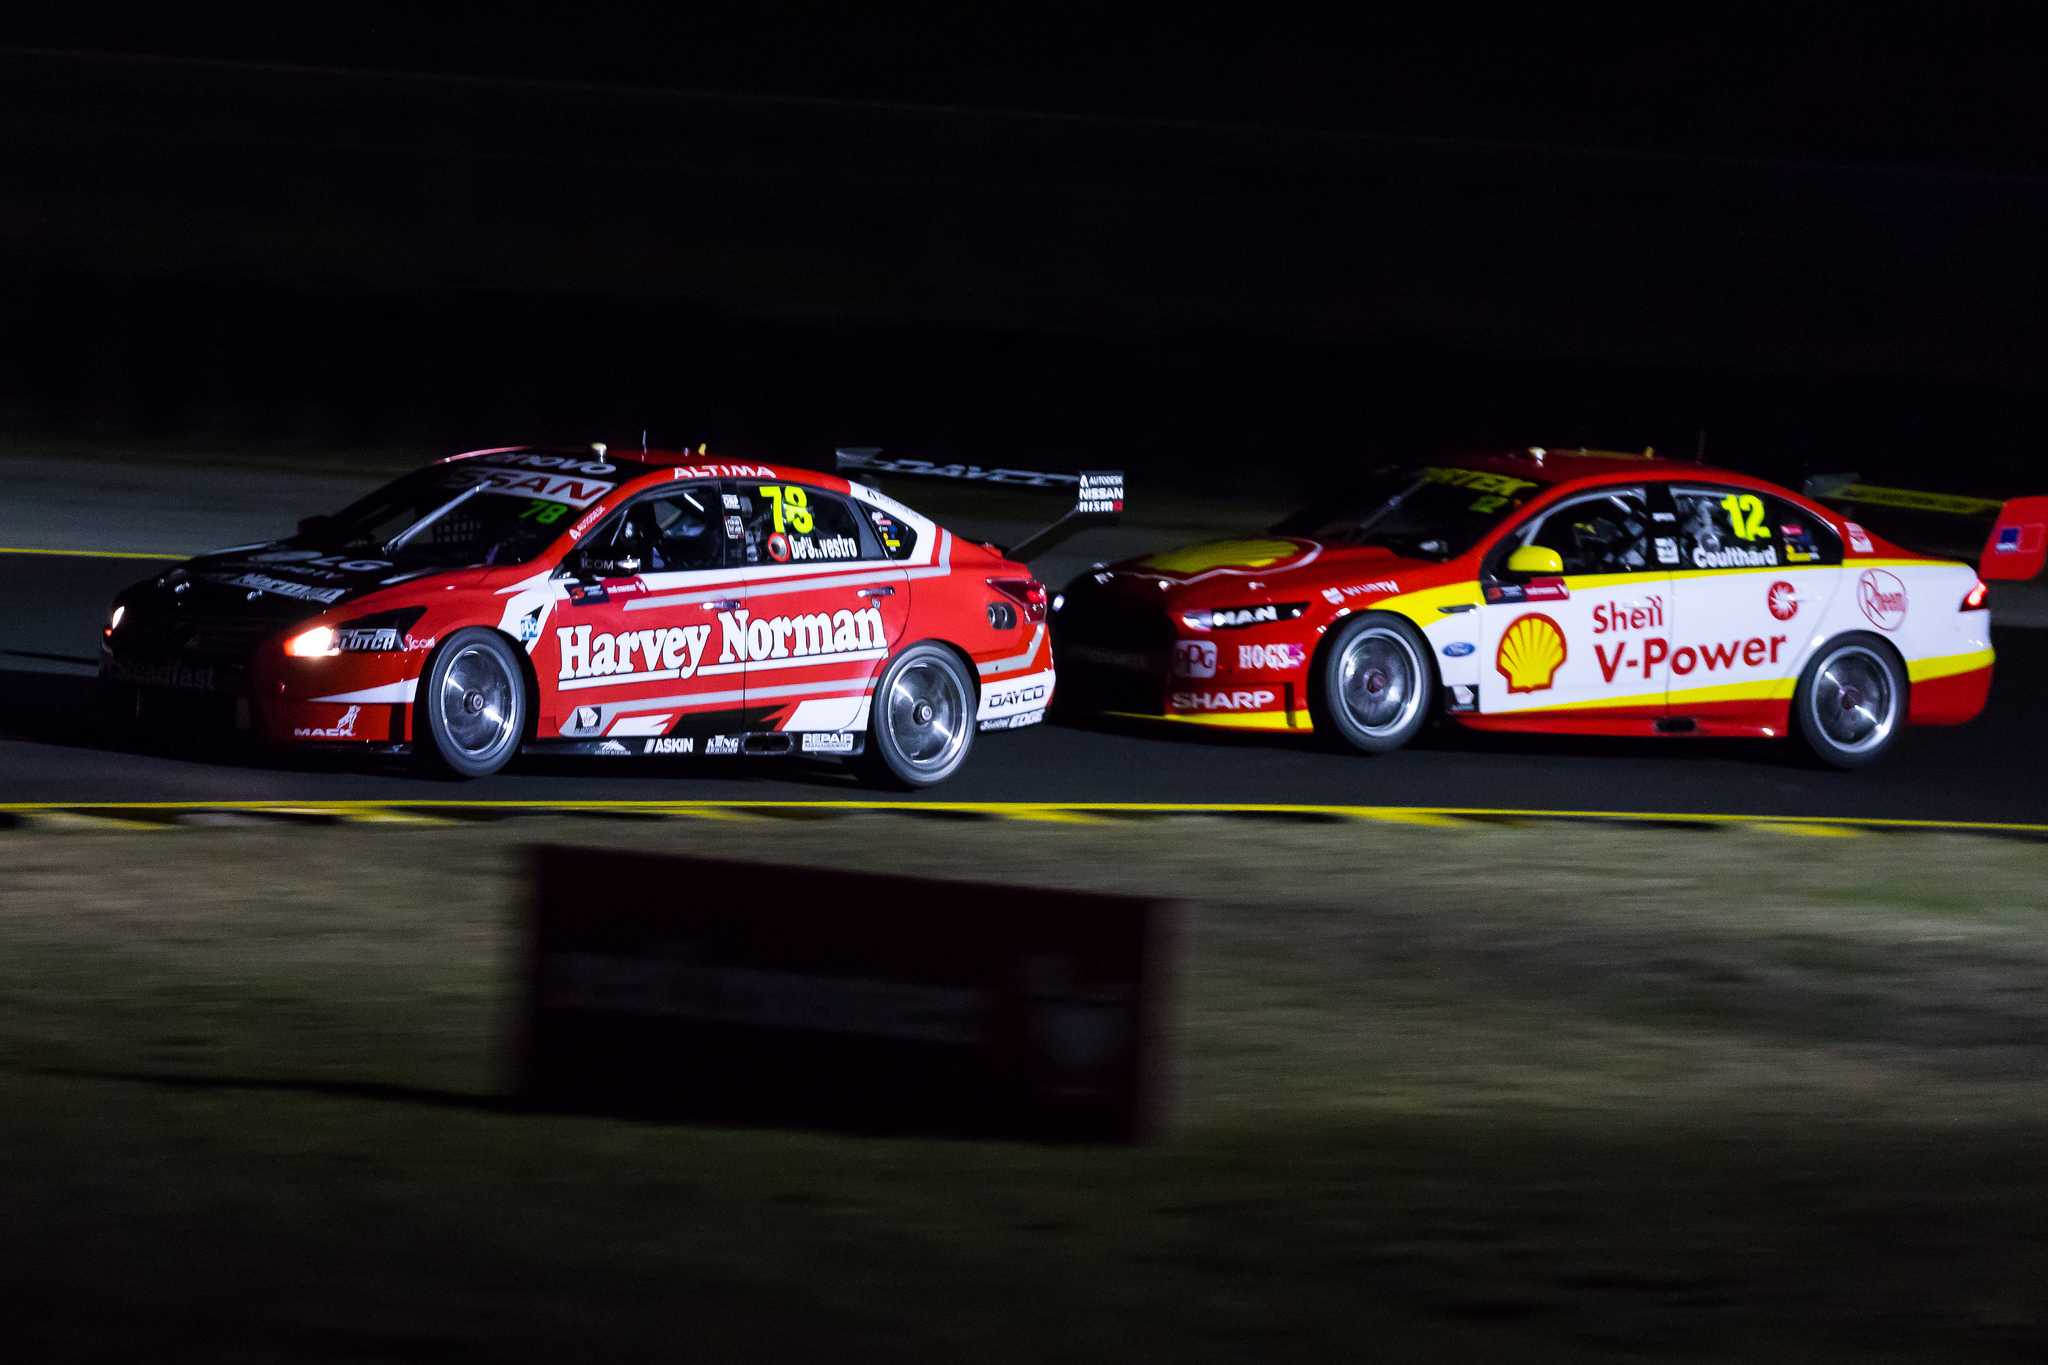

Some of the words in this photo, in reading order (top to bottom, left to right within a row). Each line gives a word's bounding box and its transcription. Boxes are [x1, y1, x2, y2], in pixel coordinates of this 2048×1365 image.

[674, 465, 777, 479] ALTIMA
[1079, 488, 1124, 500] NISSAN
[518, 499, 568, 524] 78
[759, 486, 813, 533] 78
[1721, 494, 1771, 541] 12
[1693, 545, 1778, 568] Coulthard
[1594, 596, 1663, 633] Shell
[556, 624, 711, 680] Harvey
[718, 607, 887, 664] Norman
[1594, 635, 1787, 683] V-Power
[989, 684, 1045, 708] DAYCO
[1172, 691, 1275, 709] SHARP
[294, 728, 356, 737] MACK
[654, 738, 694, 753] ASKIN
